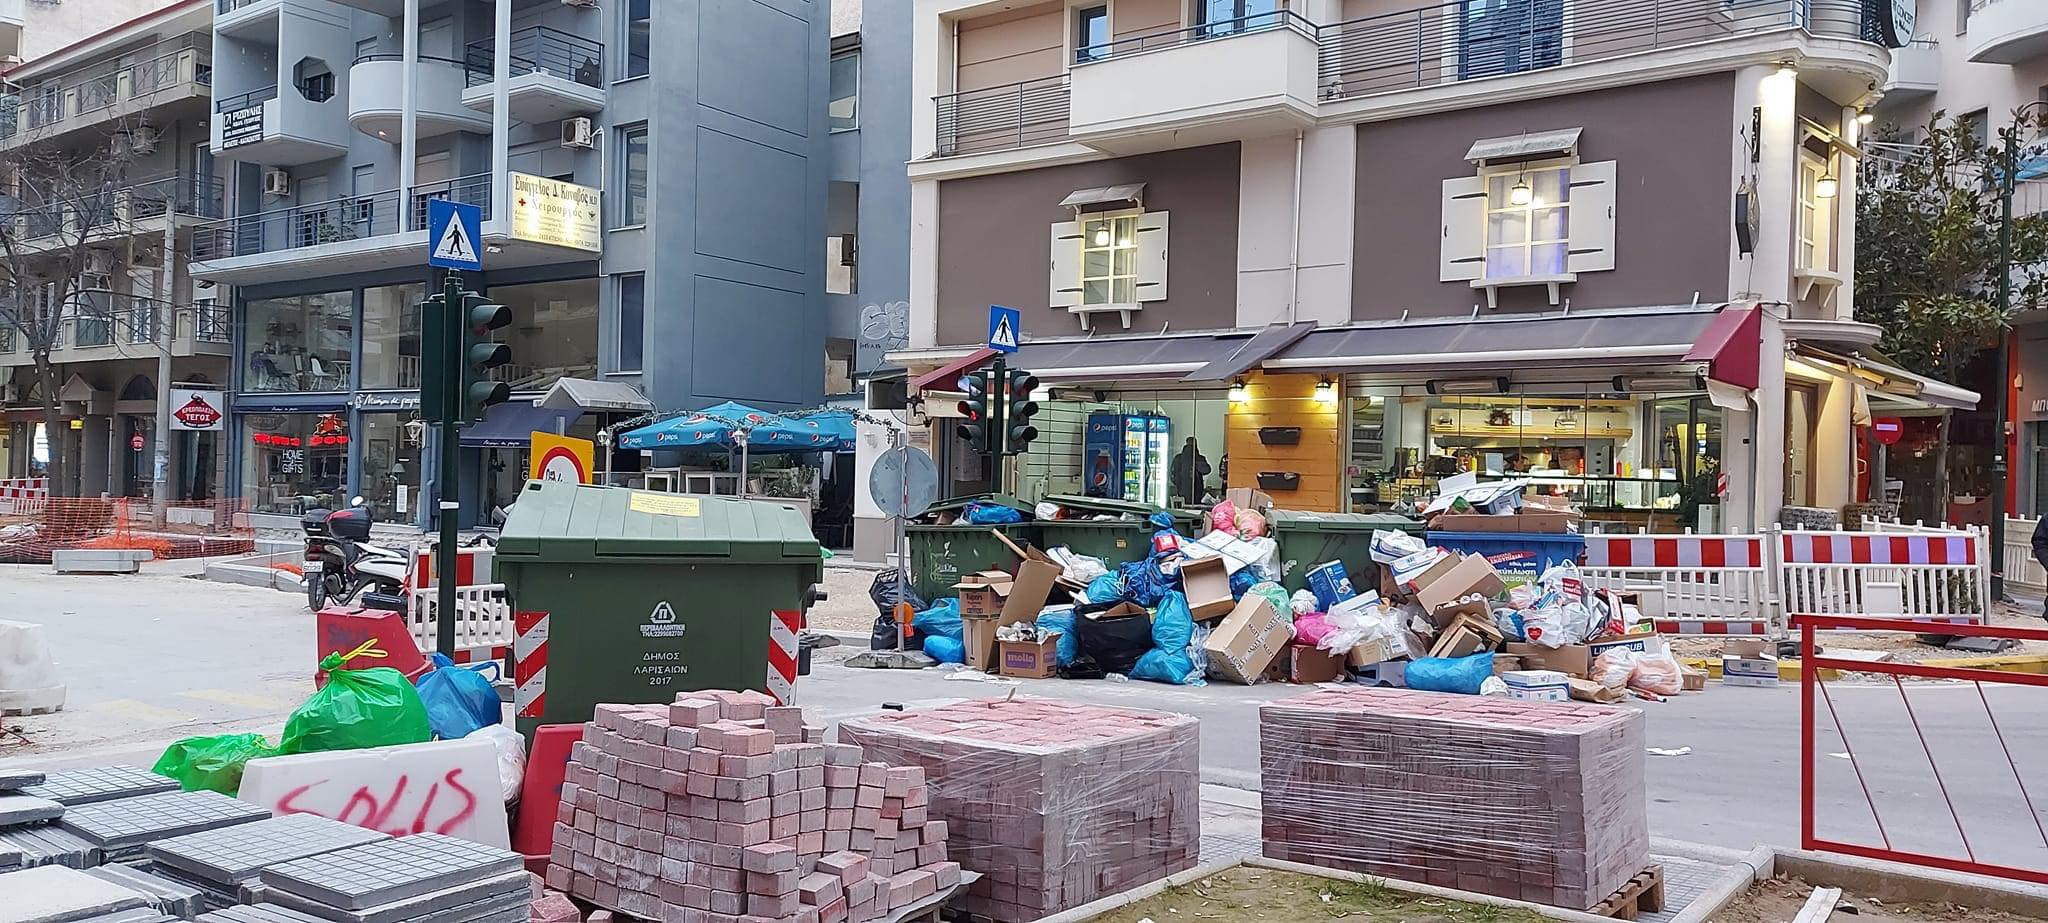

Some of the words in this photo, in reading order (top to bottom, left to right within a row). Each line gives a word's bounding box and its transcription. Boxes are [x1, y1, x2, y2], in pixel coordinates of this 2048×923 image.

[185, 413, 211, 421] ΤΕΓΟΣ
[282, 449, 304, 459] HOME
[282, 464, 304, 474] GIFTS
[643, 652, 680, 661] ΔΗΜΟΣ
[633, 665, 688, 674] ΛΑΡΙΣΑΙΩΝ
[649, 676, 672, 685] 2017
